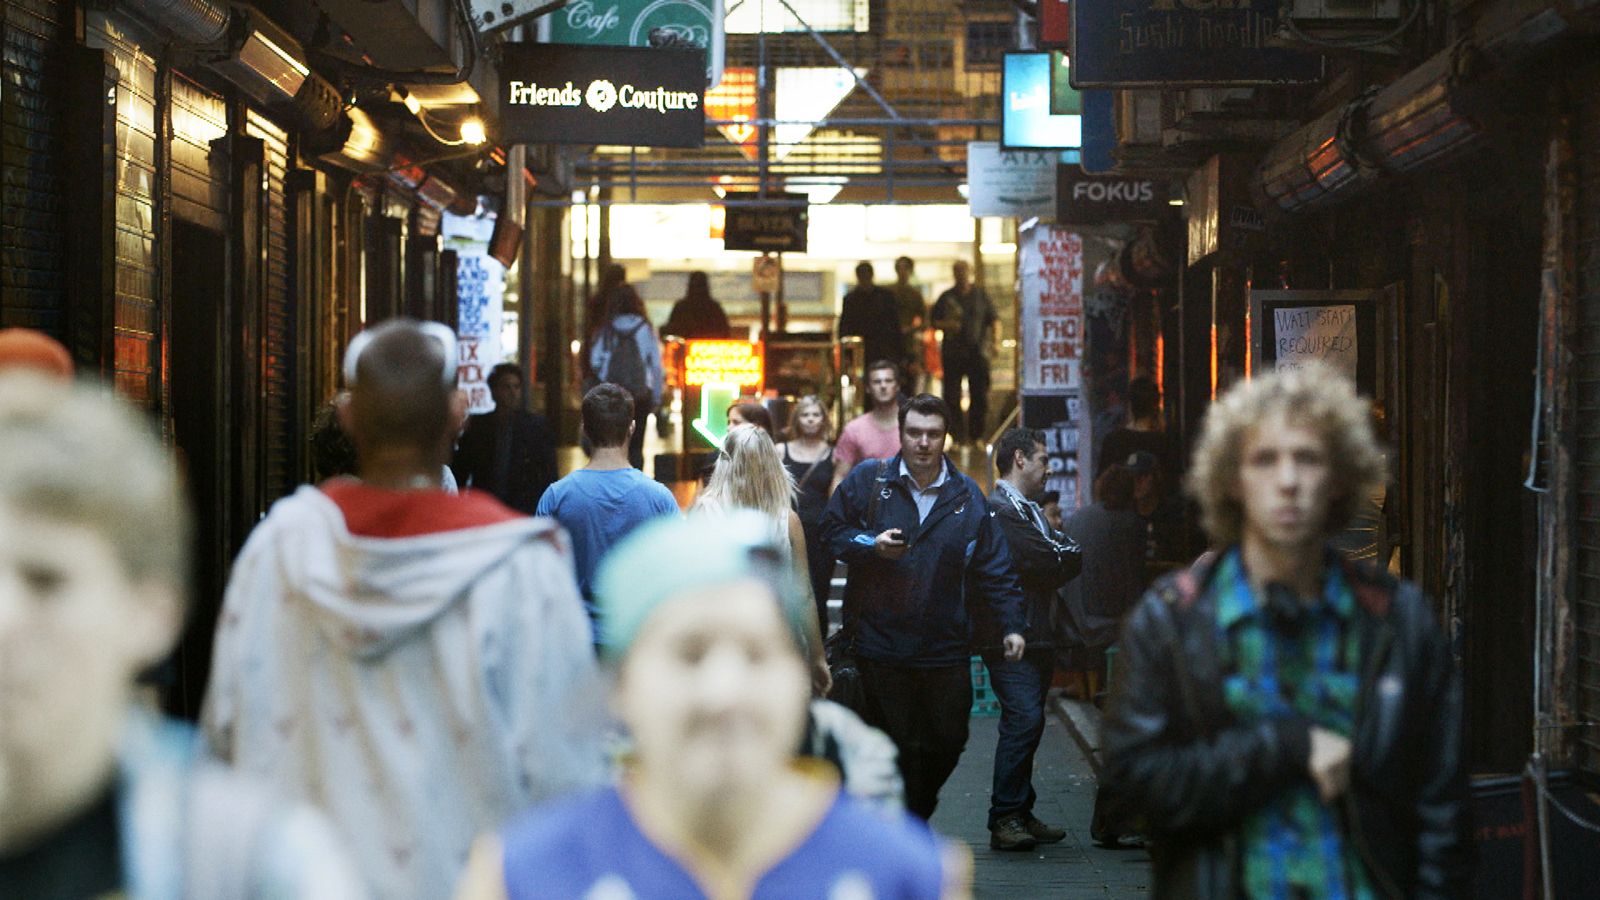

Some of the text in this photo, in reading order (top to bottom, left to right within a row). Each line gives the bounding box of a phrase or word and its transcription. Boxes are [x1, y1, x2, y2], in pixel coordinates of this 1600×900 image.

[509, 81, 699, 114] Friends Couture
[1073, 181, 1154, 201] FOKUS
[1276, 311, 1311, 332] WAIT
[1279, 336, 1353, 357] REQUIRED
[1040, 363, 1070, 385] FRI
